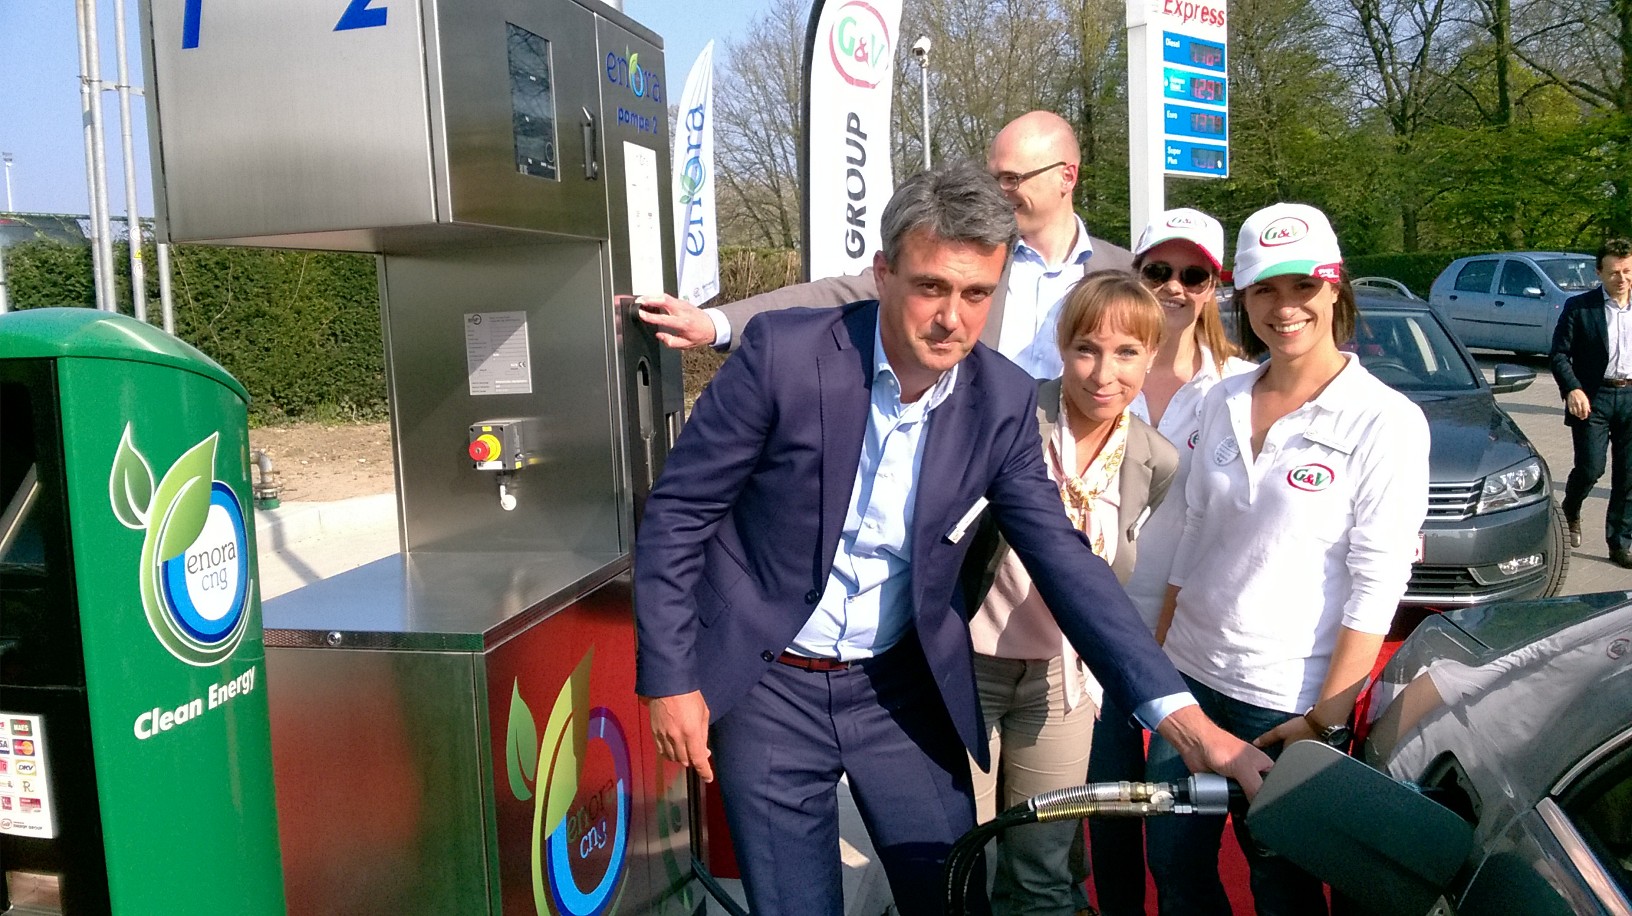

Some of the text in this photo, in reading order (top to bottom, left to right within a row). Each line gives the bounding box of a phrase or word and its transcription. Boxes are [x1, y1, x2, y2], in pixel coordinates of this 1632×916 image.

[1163, 0, 1225, 25] Express
[837, 16, 885, 69] G&V
[606, 50, 662, 102] enora
[616, 105, 658, 135] pompe 2
[1167, 145, 1182, 156] Super
[684, 103, 706, 257] enora
[845, 111, 868, 259] GROUP
[1292, 467, 1331, 486] G&V
[186, 540, 237, 576] enora
[201, 566, 229, 591] cng
[133, 666, 255, 741] Clean Energy
